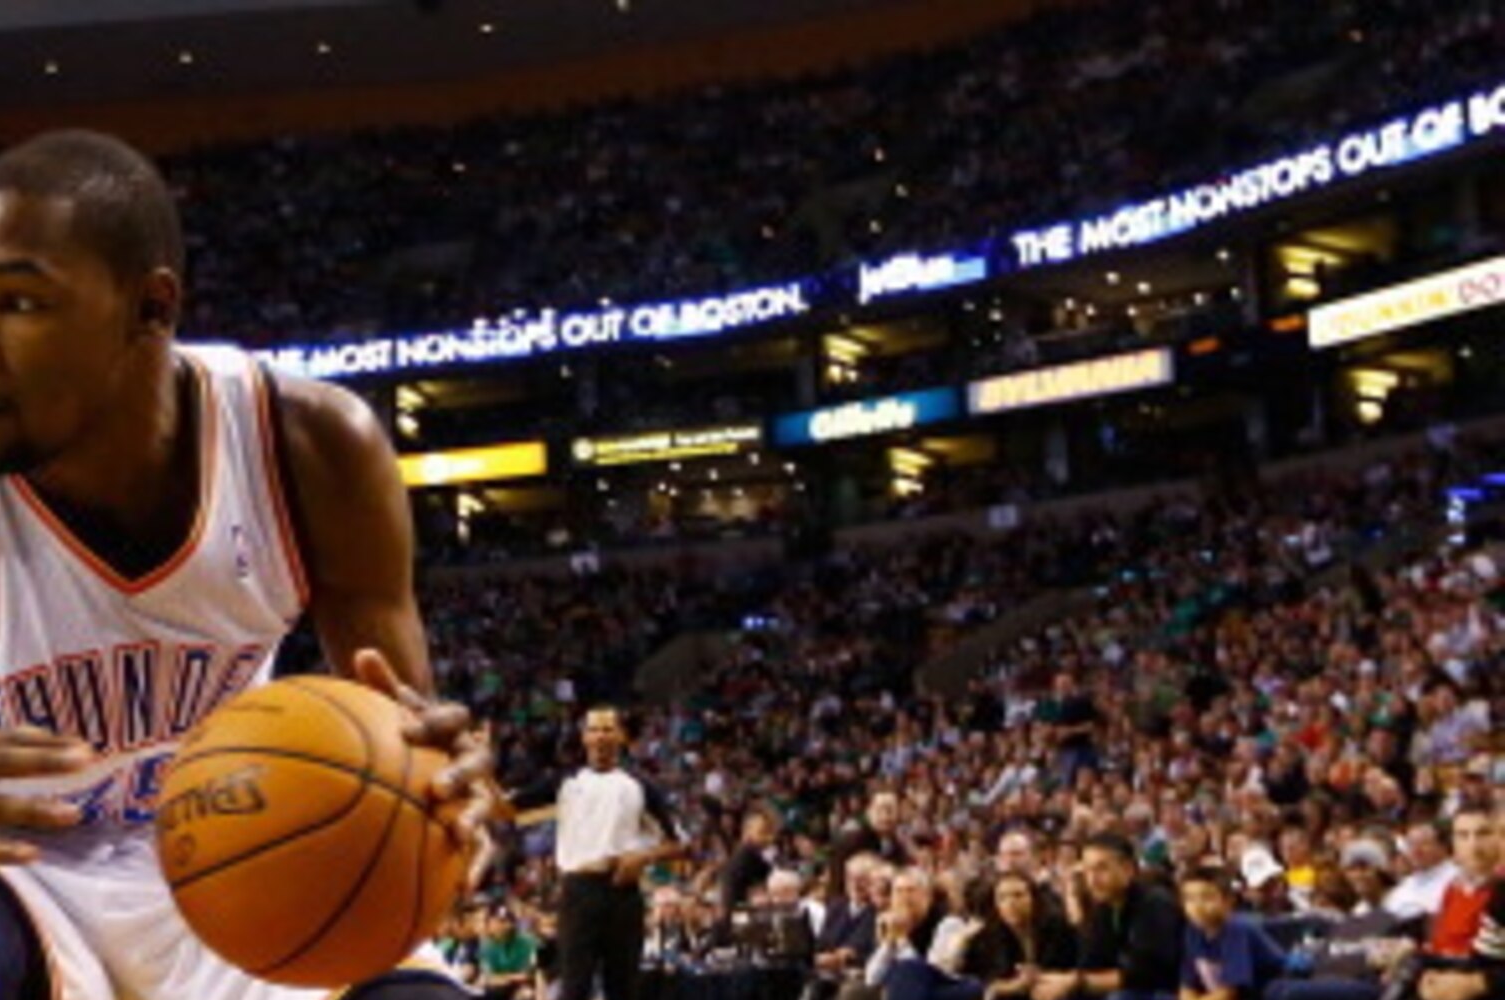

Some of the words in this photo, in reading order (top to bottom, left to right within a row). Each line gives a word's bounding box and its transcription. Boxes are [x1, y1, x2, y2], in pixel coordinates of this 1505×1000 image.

[1011, 221, 1073, 264] THE
[1079, 200, 1165, 254] MOST
[1169, 143, 1334, 228] NONSTOPS
[1338, 117, 1406, 173] OUT
[1412, 102, 1463, 150] OF
[312, 340, 393, 376] MOST
[562, 308, 623, 345] OUT
